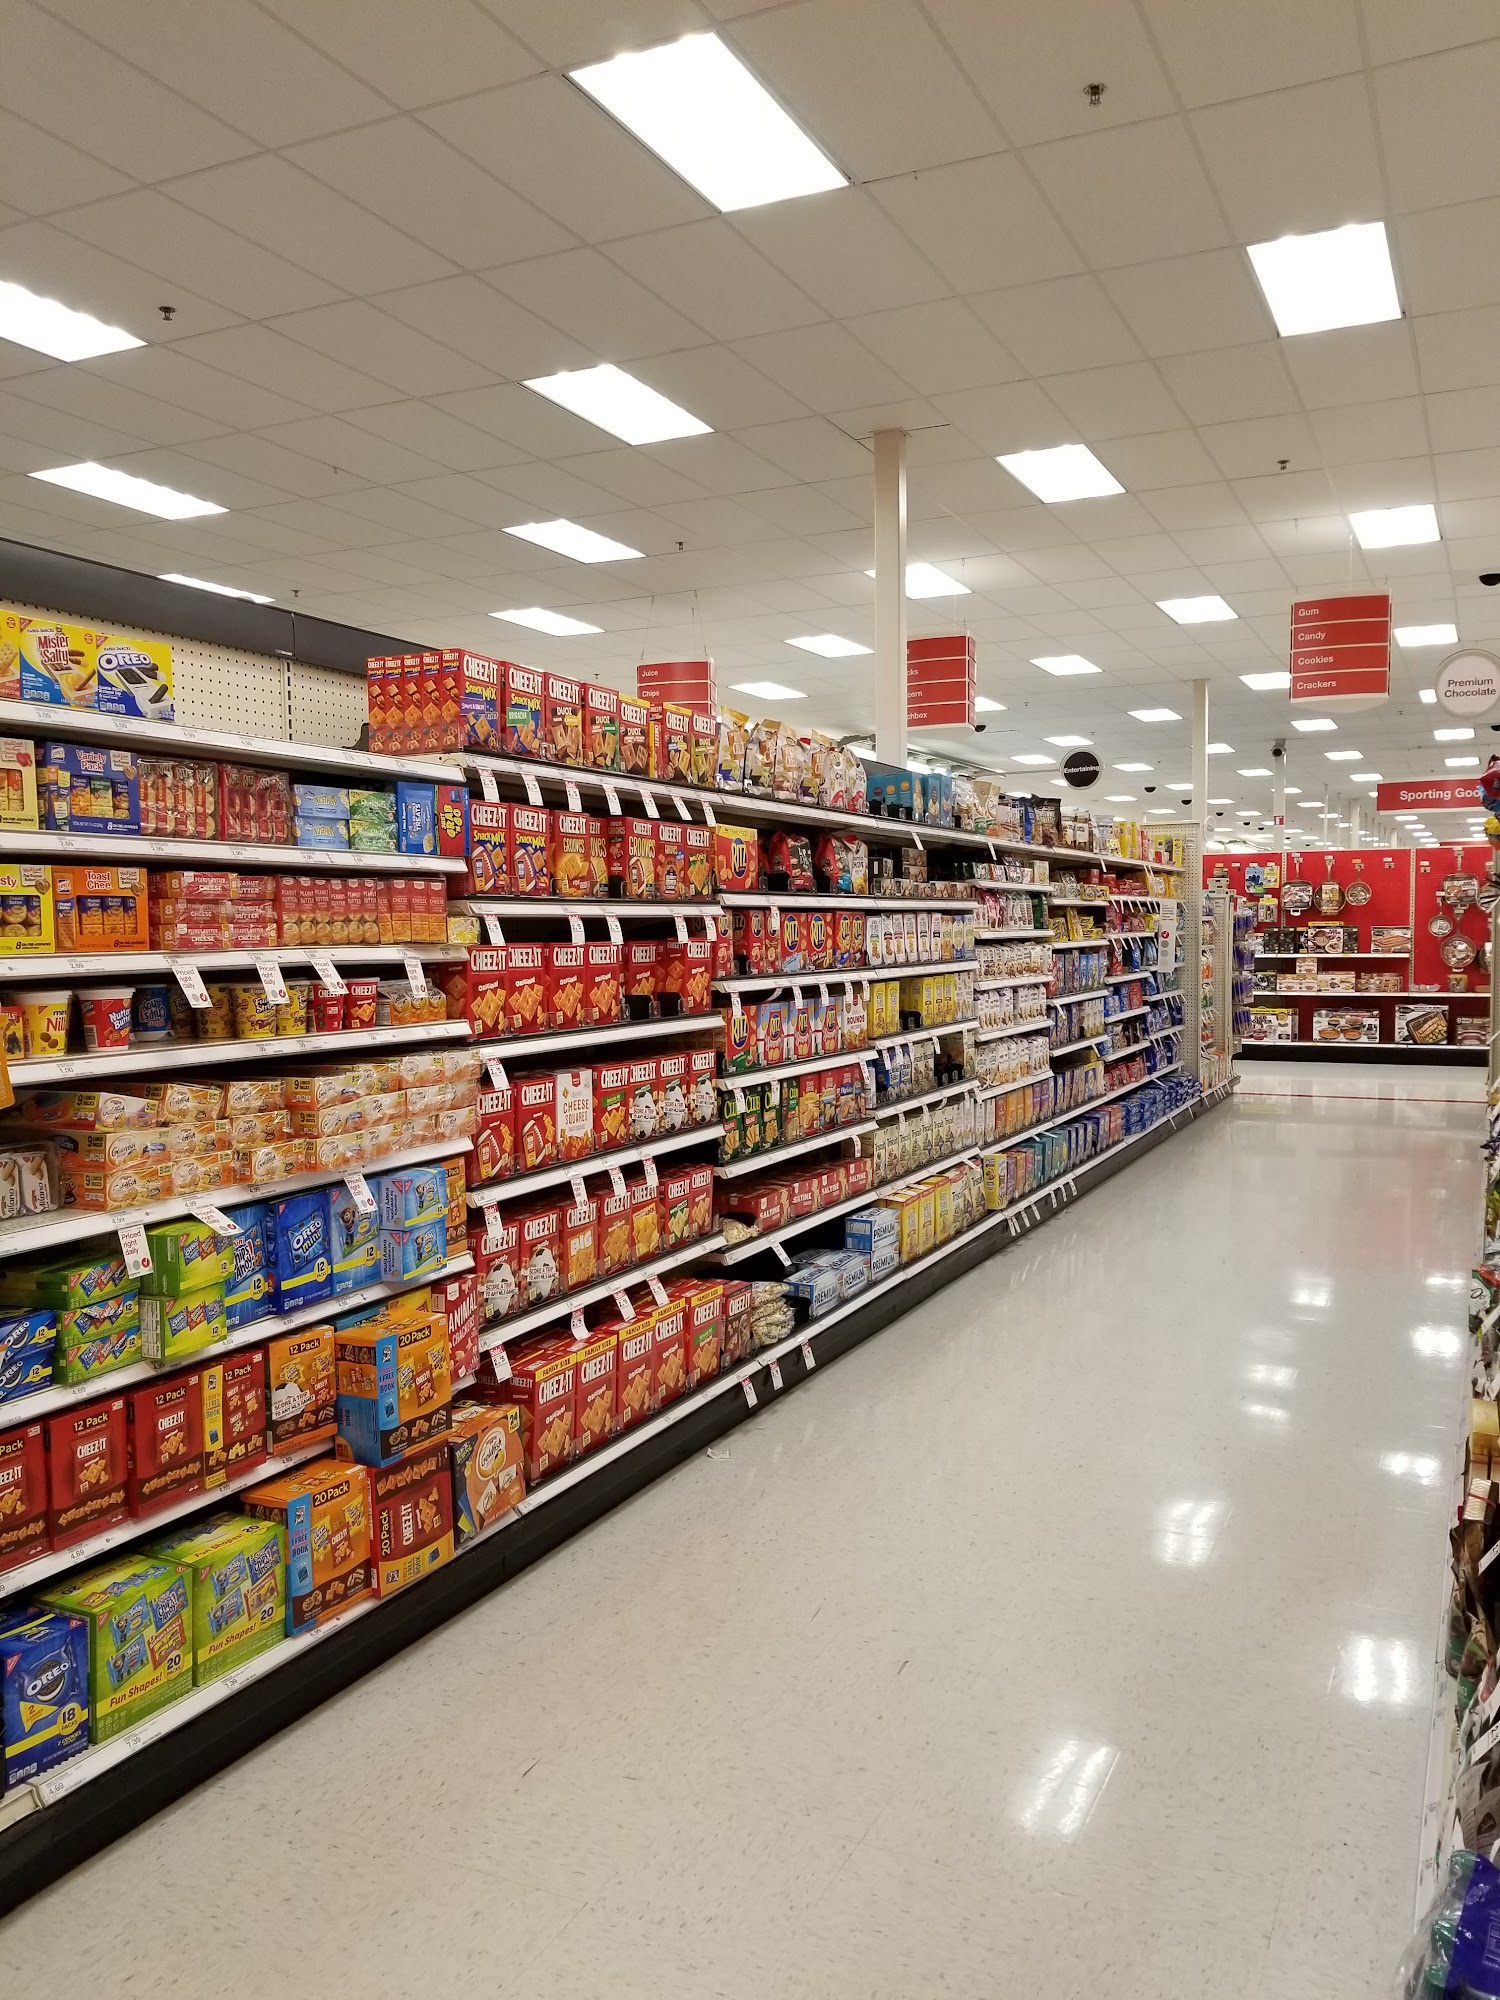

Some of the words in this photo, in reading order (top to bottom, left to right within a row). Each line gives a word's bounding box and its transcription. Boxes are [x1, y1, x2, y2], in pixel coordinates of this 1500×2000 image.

[1298, 608, 1319, 617] Gum
[37, 636, 69, 649] Mister
[1298, 631, 1326, 642] Candy
[43, 649, 69, 666] Salty
[99, 653, 151, 670] OREO
[1298, 655, 1334, 666] Cookies
[641, 669, 659, 678] Juice
[907, 668, 919, 676] cks
[1296, 679, 1337, 690] Crackers
[1447, 677, 1494, 688] Premium
[641, 690, 660, 698] Chips
[907, 690, 923, 698] corn
[1444, 687, 1497, 698] Chocolate
[907, 711, 928, 720] chbox
[75, 749, 107, 764] Variety
[80, 760, 104, 772] Pack
[1063, 764, 1100, 774] Entertaining
[1400, 789, 1452, 801] Sporting
[1454, 787, 1482, 799] Goo
[732, 842, 747, 871] RITZ
[85, 870, 112, 882] Toast
[171, 880, 180, 889] 8
[86, 880, 112, 890] Chee
[164, 931, 173, 940] 8
[784, 920, 799, 944] RITZ
[810, 920, 825, 944] RITZ
[470, 949, 507, 972] CHEEZ-IT
[508, 946, 542, 968] CHEEZ-IT
[553, 946, 585, 967] CHEEZ-IT
[175, 968, 195, 976] Priced
[258, 964, 277, 972] Priced
[179, 975, 193, 984] right
[351, 984, 377, 996] CHEEZ-IT
[46, 1017, 68, 1033] Nill
[847, 1013, 865, 1026] ROUNDS
[660, 1056, 685, 1077] CHEEZ-IT
[692, 1051, 715, 1071] CHEEZ-IT
[601, 1067, 629, 1089] CHEEZ-IT
[629, 1062, 657, 1083] CHEEZ-IT
[521, 1082, 554, 1106] CHEEZ-IT
[563, 1098, 589, 1114] CHEESE
[745, 1096, 761, 1113] CLUB
[121, 1231, 142, 1240] Priced
[293, 1220, 322, 1250] OREO
[524, 1213, 558, 1242] CHEEZ-IT
[873, 1219, 895, 1240] PREMIUM
[124, 1239, 138, 1249] right
[125, 1247, 140, 1256] daily
[302, 1232, 321, 1254] mini
[366, 1246, 375, 1256] 12
[570, 1231, 593, 1257] BIG
[317, 1261, 326, 1273] 12
[872, 1252, 895, 1272] PREMIUM
[252, 1279, 262, 1290] 12
[842, 1267, 866, 1287] PREMIUM
[448, 1295, 478, 1333] ANIMAL
[694, 1299, 720, 1326] CHEEZ-IT
[6, 1321, 30, 1344] OREO
[38, 1328, 46, 1337] 12
[212, 1326, 220, 1335] 12
[655, 1312, 684, 1342] CHEEZ-IT
[399, 1334, 411, 1348] 20
[411, 1327, 431, 1345] Pack
[289, 1344, 299, 1355] 12
[300, 1338, 321, 1351] Pack
[584, 1345, 600, 1358] FAMILY
[600, 1339, 612, 1351] SIZE
[622, 1331, 653, 1362] CHEEZ-IT
[32, 1367, 40, 1376] 12
[224, 1371, 233, 1381] 12
[234, 1363, 252, 1377] Pack
[542, 1362, 560, 1377] FAMILY
[559, 1357, 572, 1369] SIZE
[580, 1349, 614, 1384] CHEEZ-IT
[379, 1380, 396, 1393] BOOK
[538, 1369, 574, 1405] CHEEZ-IT
[155, 1395, 165, 1406] 12
[165, 1387, 186, 1402] Pack
[273, 1398, 292, 1410] SCORE
[74, 1420, 84, 1432] 12
[86, 1412, 109, 1428] Pack
[158, 1410, 185, 1431] CHEEZ-IT
[509, 1412, 518, 1425] 24
[0, 1439, 24, 1456] Pack
[76, 1437, 107, 1459] CHEEZ-IT
[0, 1465, 23, 1486] EEZ-IT
[313, 1491, 327, 1506] 20
[327, 1483, 349, 1500] Pack
[247, 1525, 260, 1534] 20
[380, 1508, 389, 1537] Pack
[401, 1502, 415, 1546] CHEEZ-IT
[194, 1546, 211, 1559] Fun
[212, 1533, 244, 1549] Shapes!
[292, 1545, 309, 1558] BOOK
[381, 1537, 391, 1556] 20
[259, 1606, 274, 1621] 20
[208, 1641, 224, 1655] Fun
[225, 1623, 257, 1646] Shapes!
[166, 1655, 181, 1669] 20
[26, 1661, 70, 1697] OREO
[166, 1666, 181, 1677] PACKS
[109, 1692, 127, 1708] Fun
[128, 1673, 163, 1698] Shapes!
[62, 1707, 76, 1725] 18
[61, 1719, 78, 1732] PACKS
